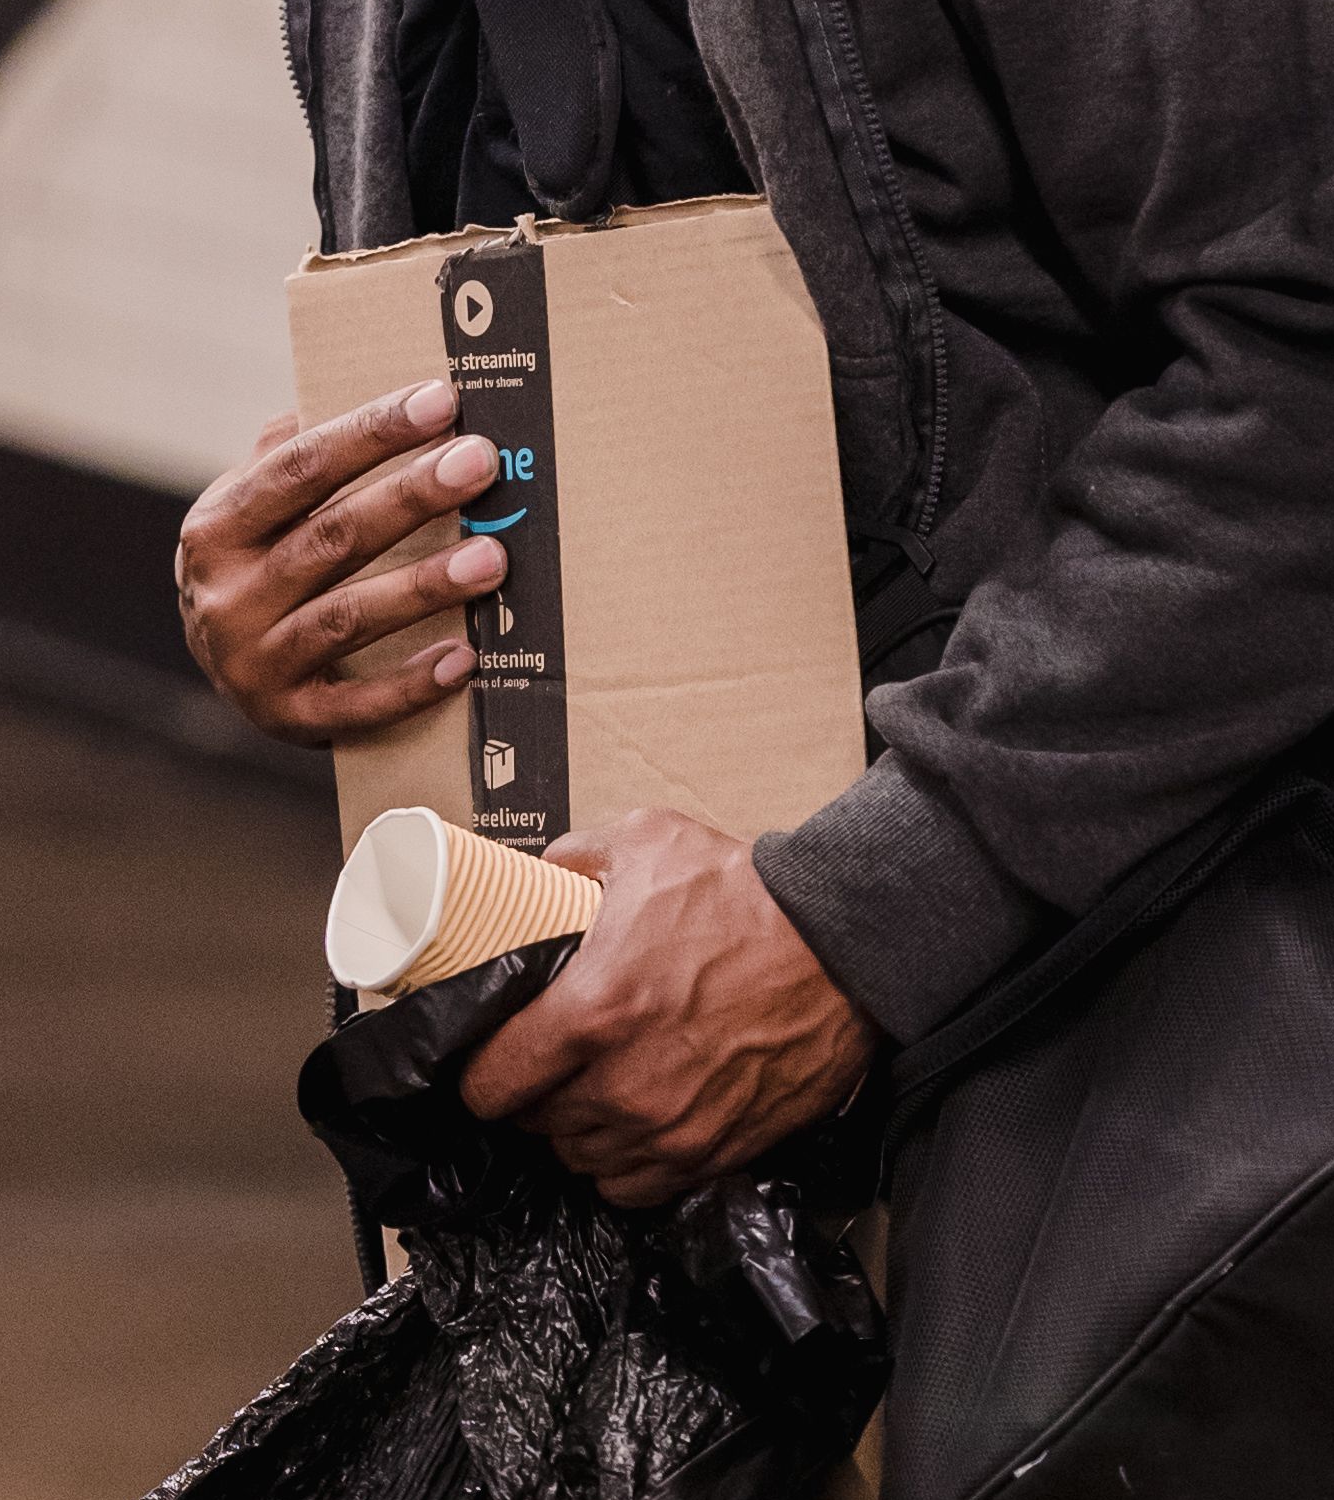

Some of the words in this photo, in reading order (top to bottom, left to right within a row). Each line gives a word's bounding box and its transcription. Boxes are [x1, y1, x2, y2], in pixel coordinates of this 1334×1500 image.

[461, 347, 536, 372] streaming
[465, 377, 482, 390] and
[484, 377, 494, 388] tv
[495, 376, 524, 388] shows
[478, 648, 545, 673] istening
[491, 676, 501, 688] of
[503, 678, 530, 690] songs
